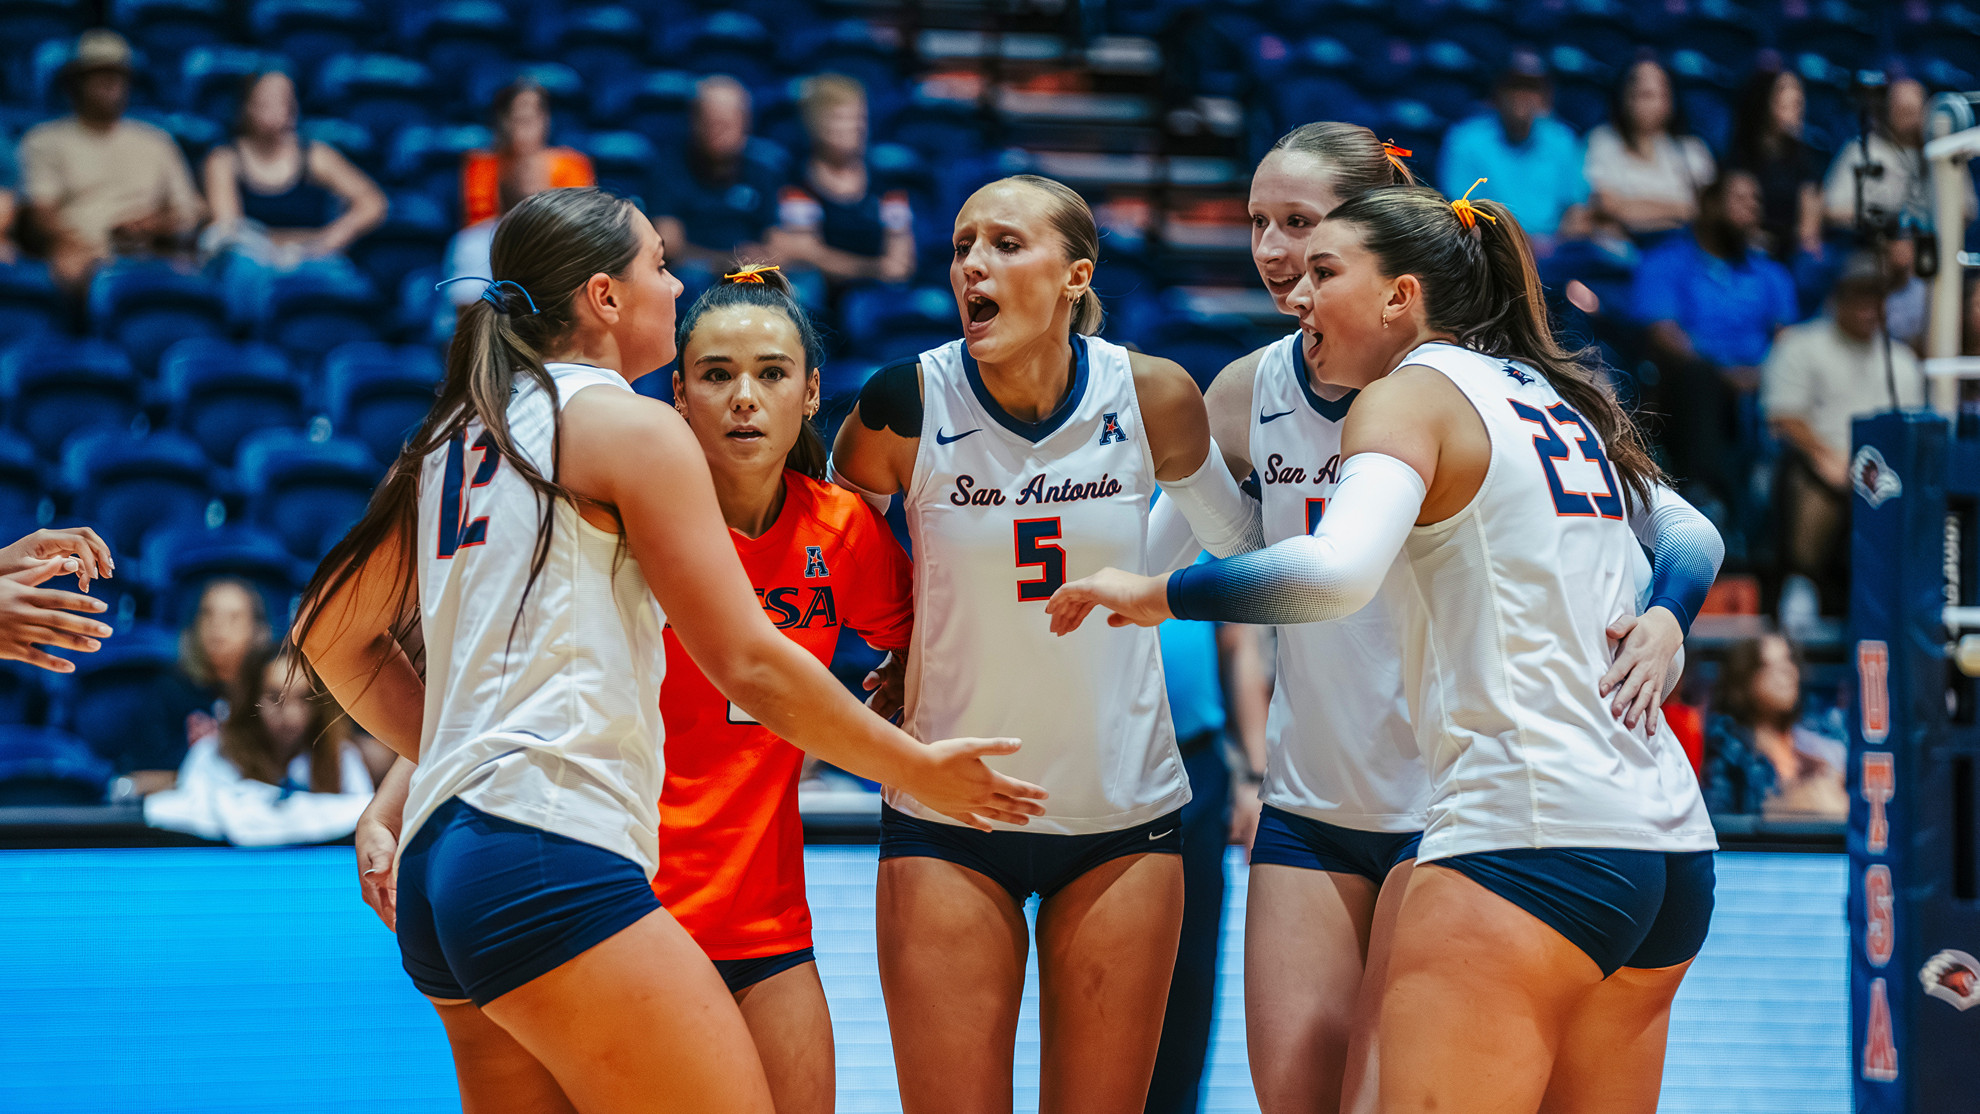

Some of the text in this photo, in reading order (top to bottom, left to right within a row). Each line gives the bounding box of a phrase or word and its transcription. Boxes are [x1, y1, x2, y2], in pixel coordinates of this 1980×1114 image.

[950, 473, 1122, 506] San Antonio
[1264, 453, 1341, 485] San A
[1506, 397, 1623, 521] 23
[437, 427, 502, 559] 12
[1013, 516, 1067, 602] 5
[756, 586, 838, 630] SA
